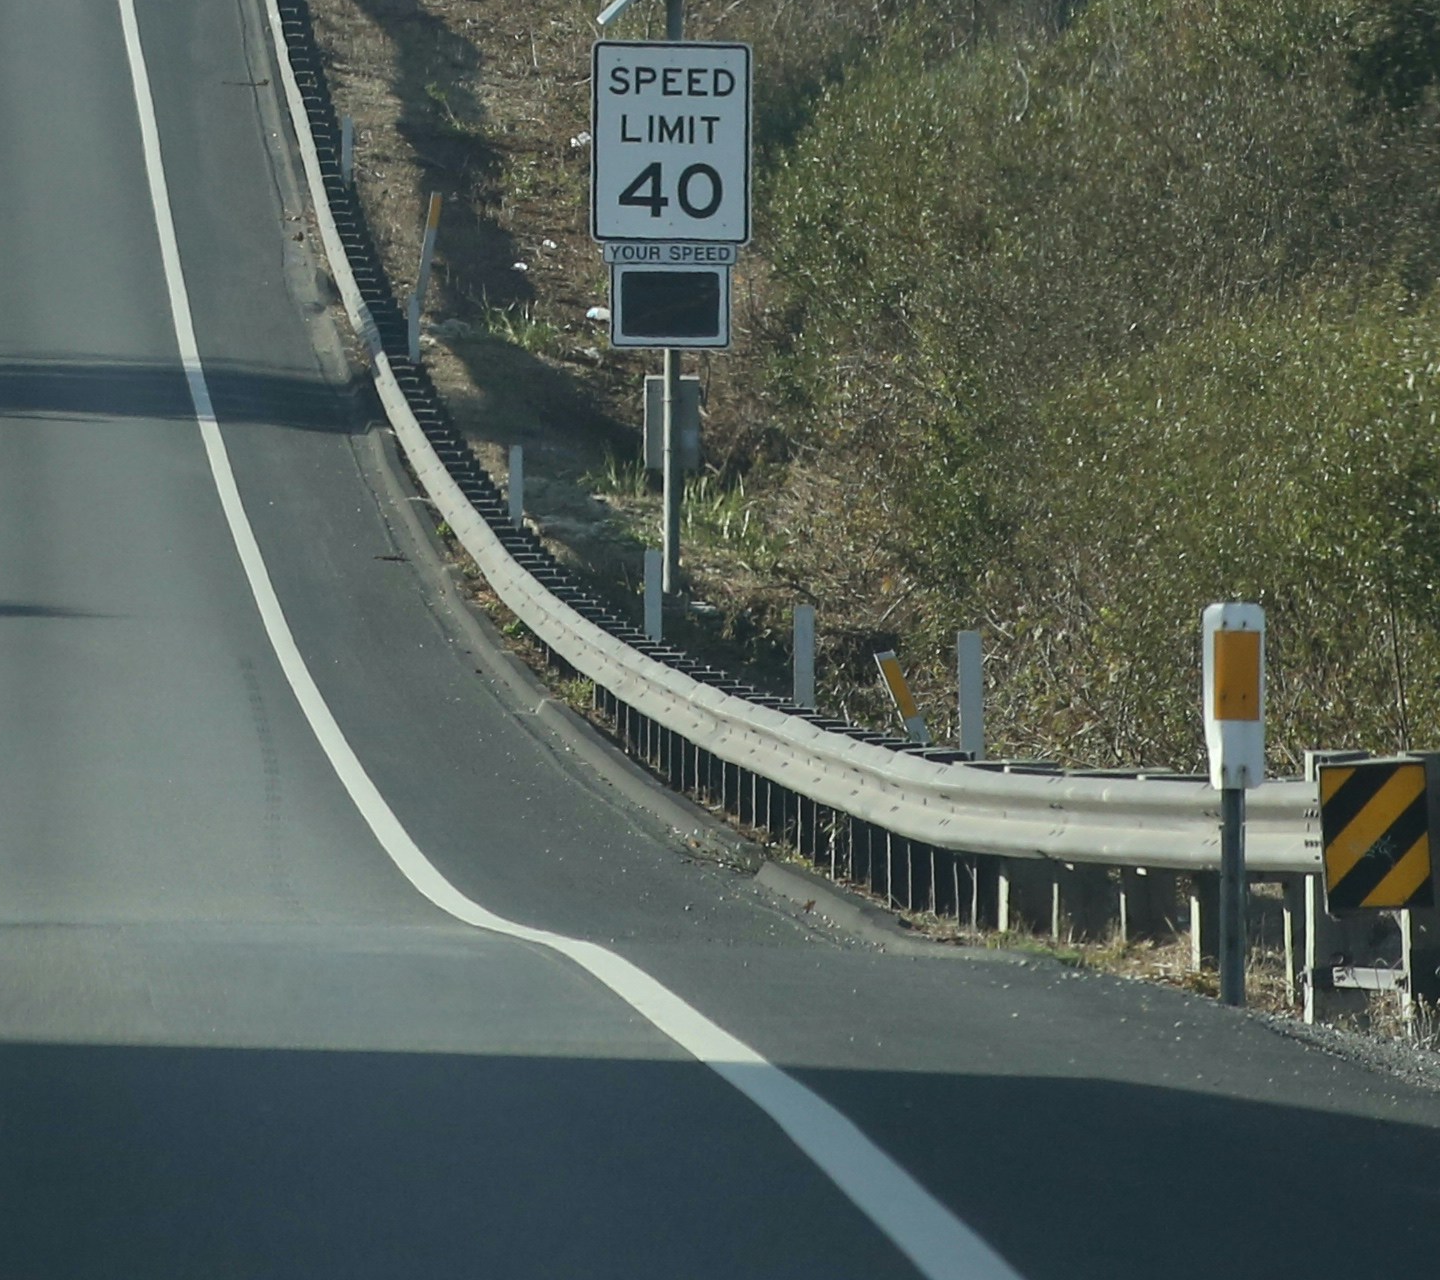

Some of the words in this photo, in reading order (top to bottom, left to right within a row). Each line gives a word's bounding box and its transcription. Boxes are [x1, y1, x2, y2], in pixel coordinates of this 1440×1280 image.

[608, 66, 736, 97] SPEED
[620, 113, 721, 145] LIMIT
[618, 161, 724, 220] 40
[610, 244, 661, 261] YOUR
[668, 245, 731, 262] SPEED
